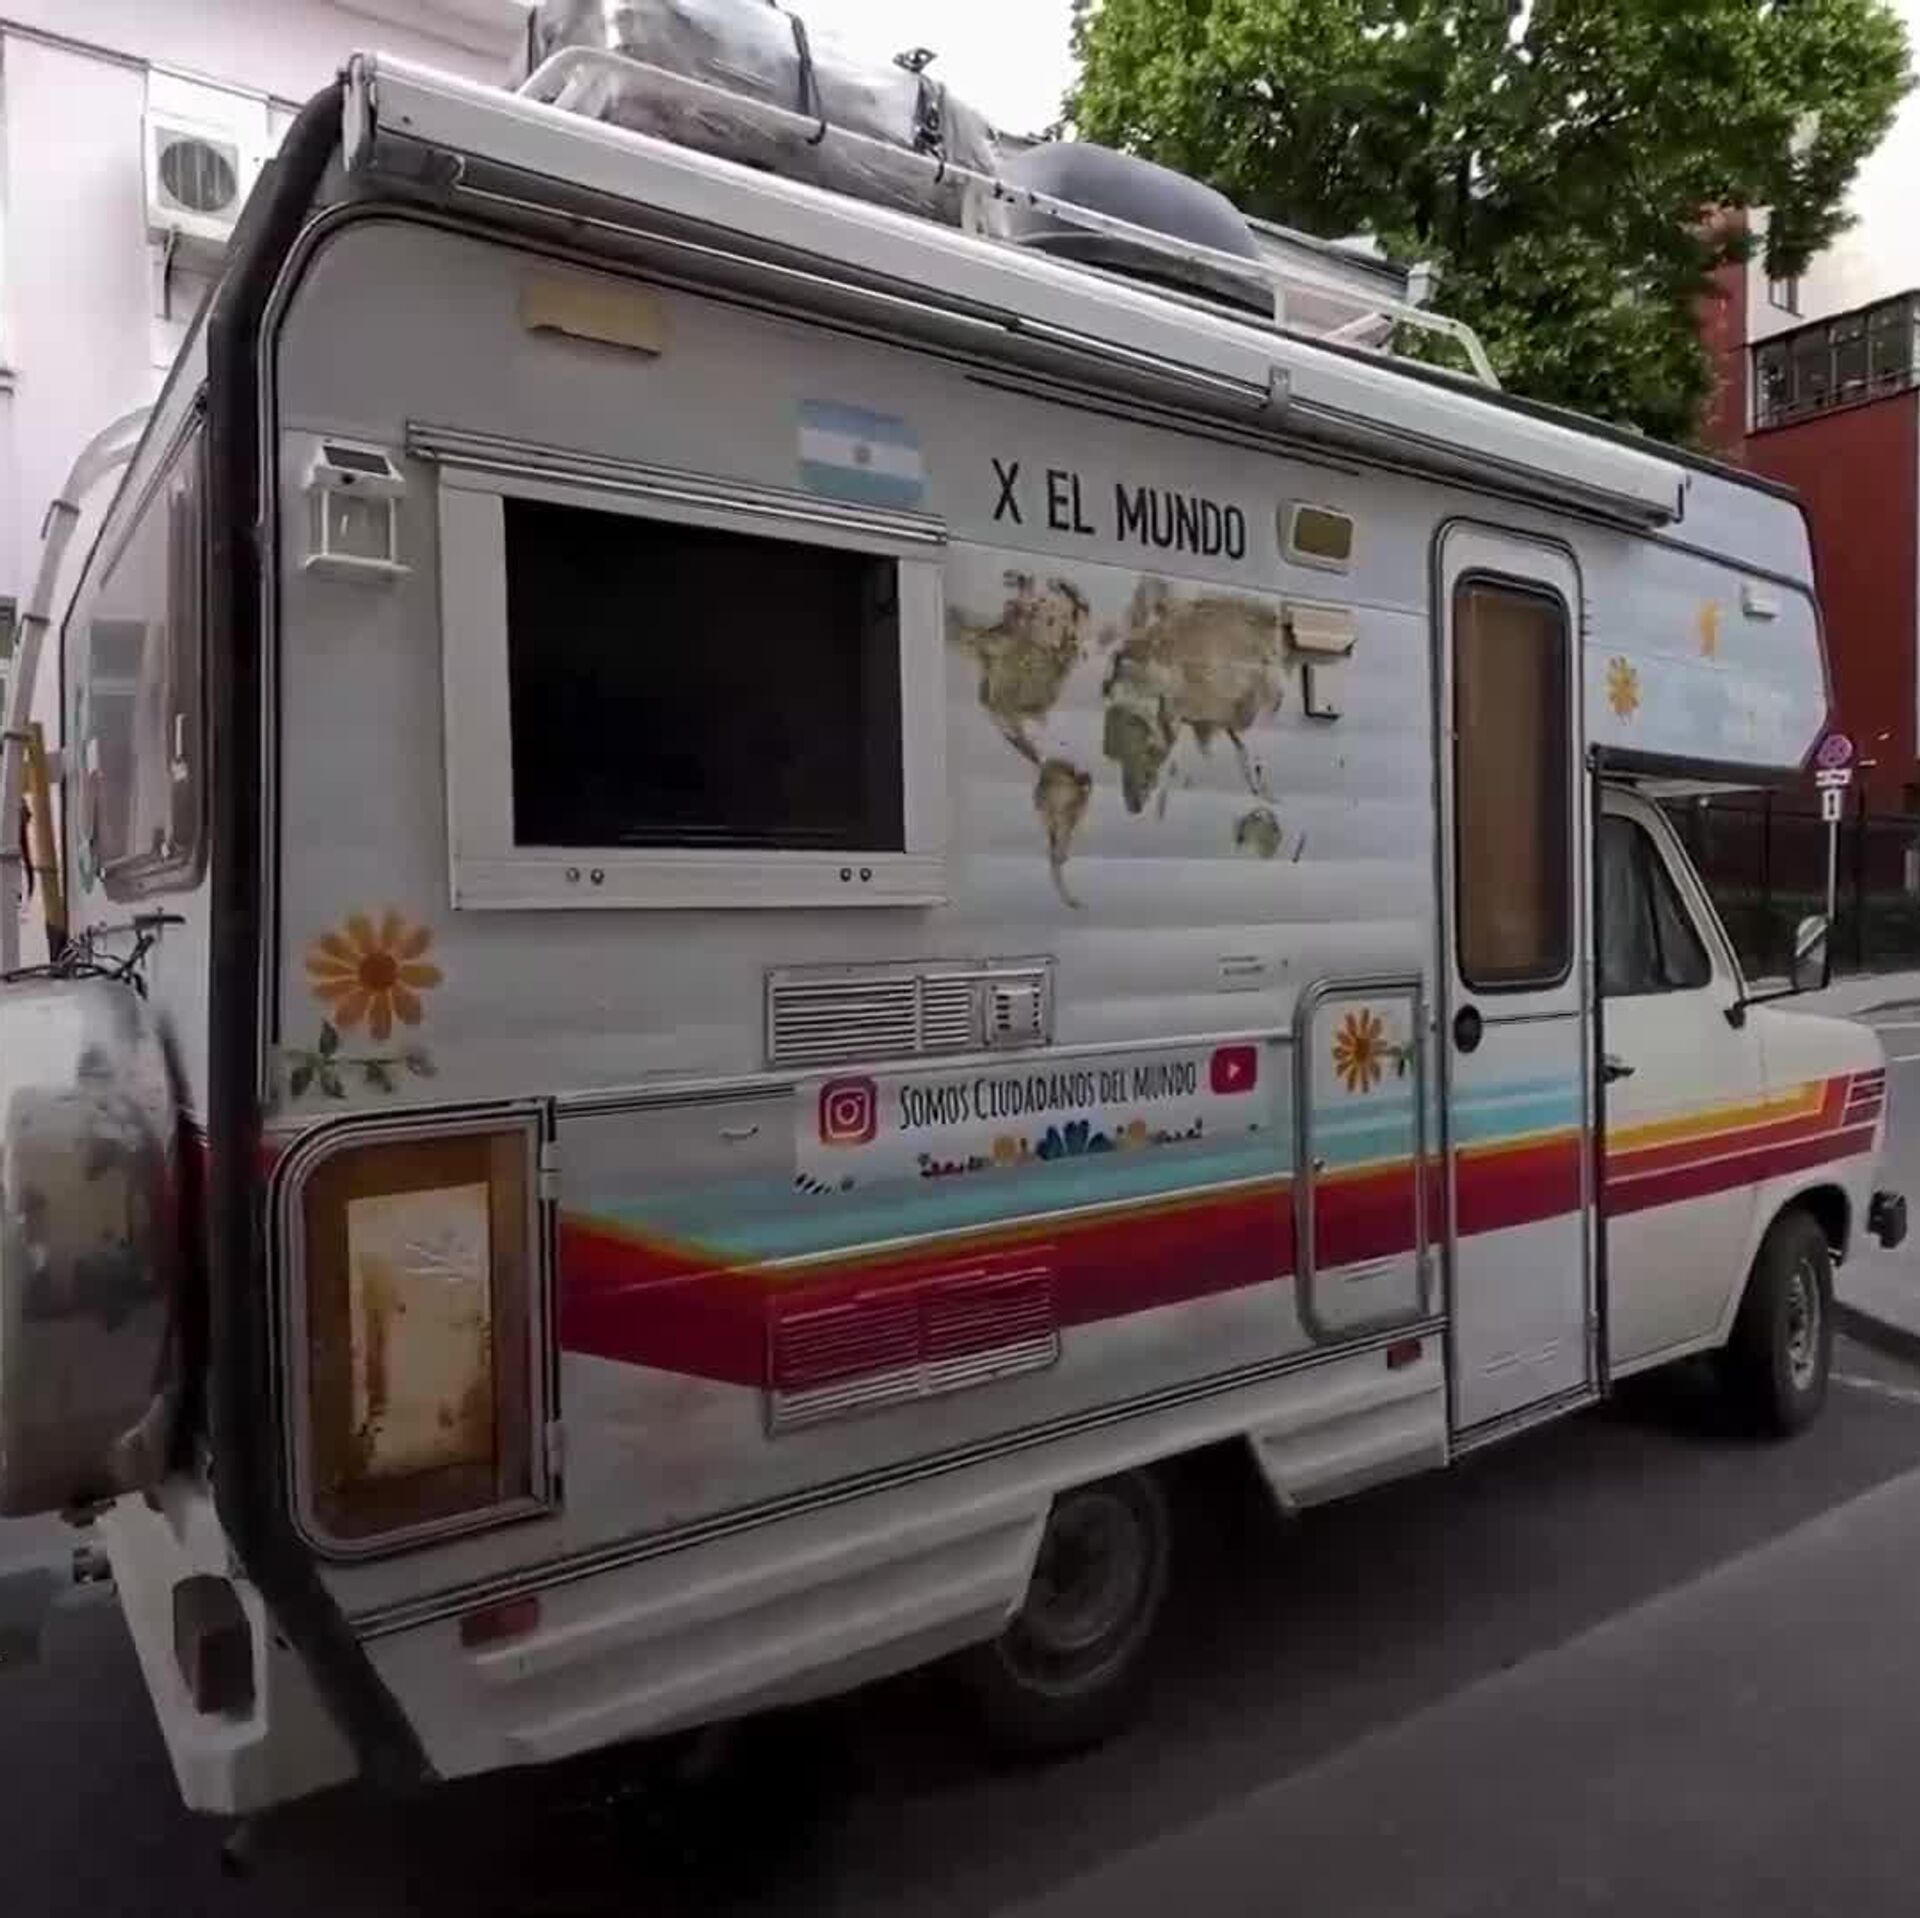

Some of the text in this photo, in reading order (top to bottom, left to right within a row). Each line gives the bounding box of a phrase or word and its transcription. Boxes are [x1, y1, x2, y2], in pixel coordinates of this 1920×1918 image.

[991, 457, 1246, 561] X EL MUNDO
[899, 1061, 1197, 1130] SOMOS CIUDADANOS DEL MUNDO
